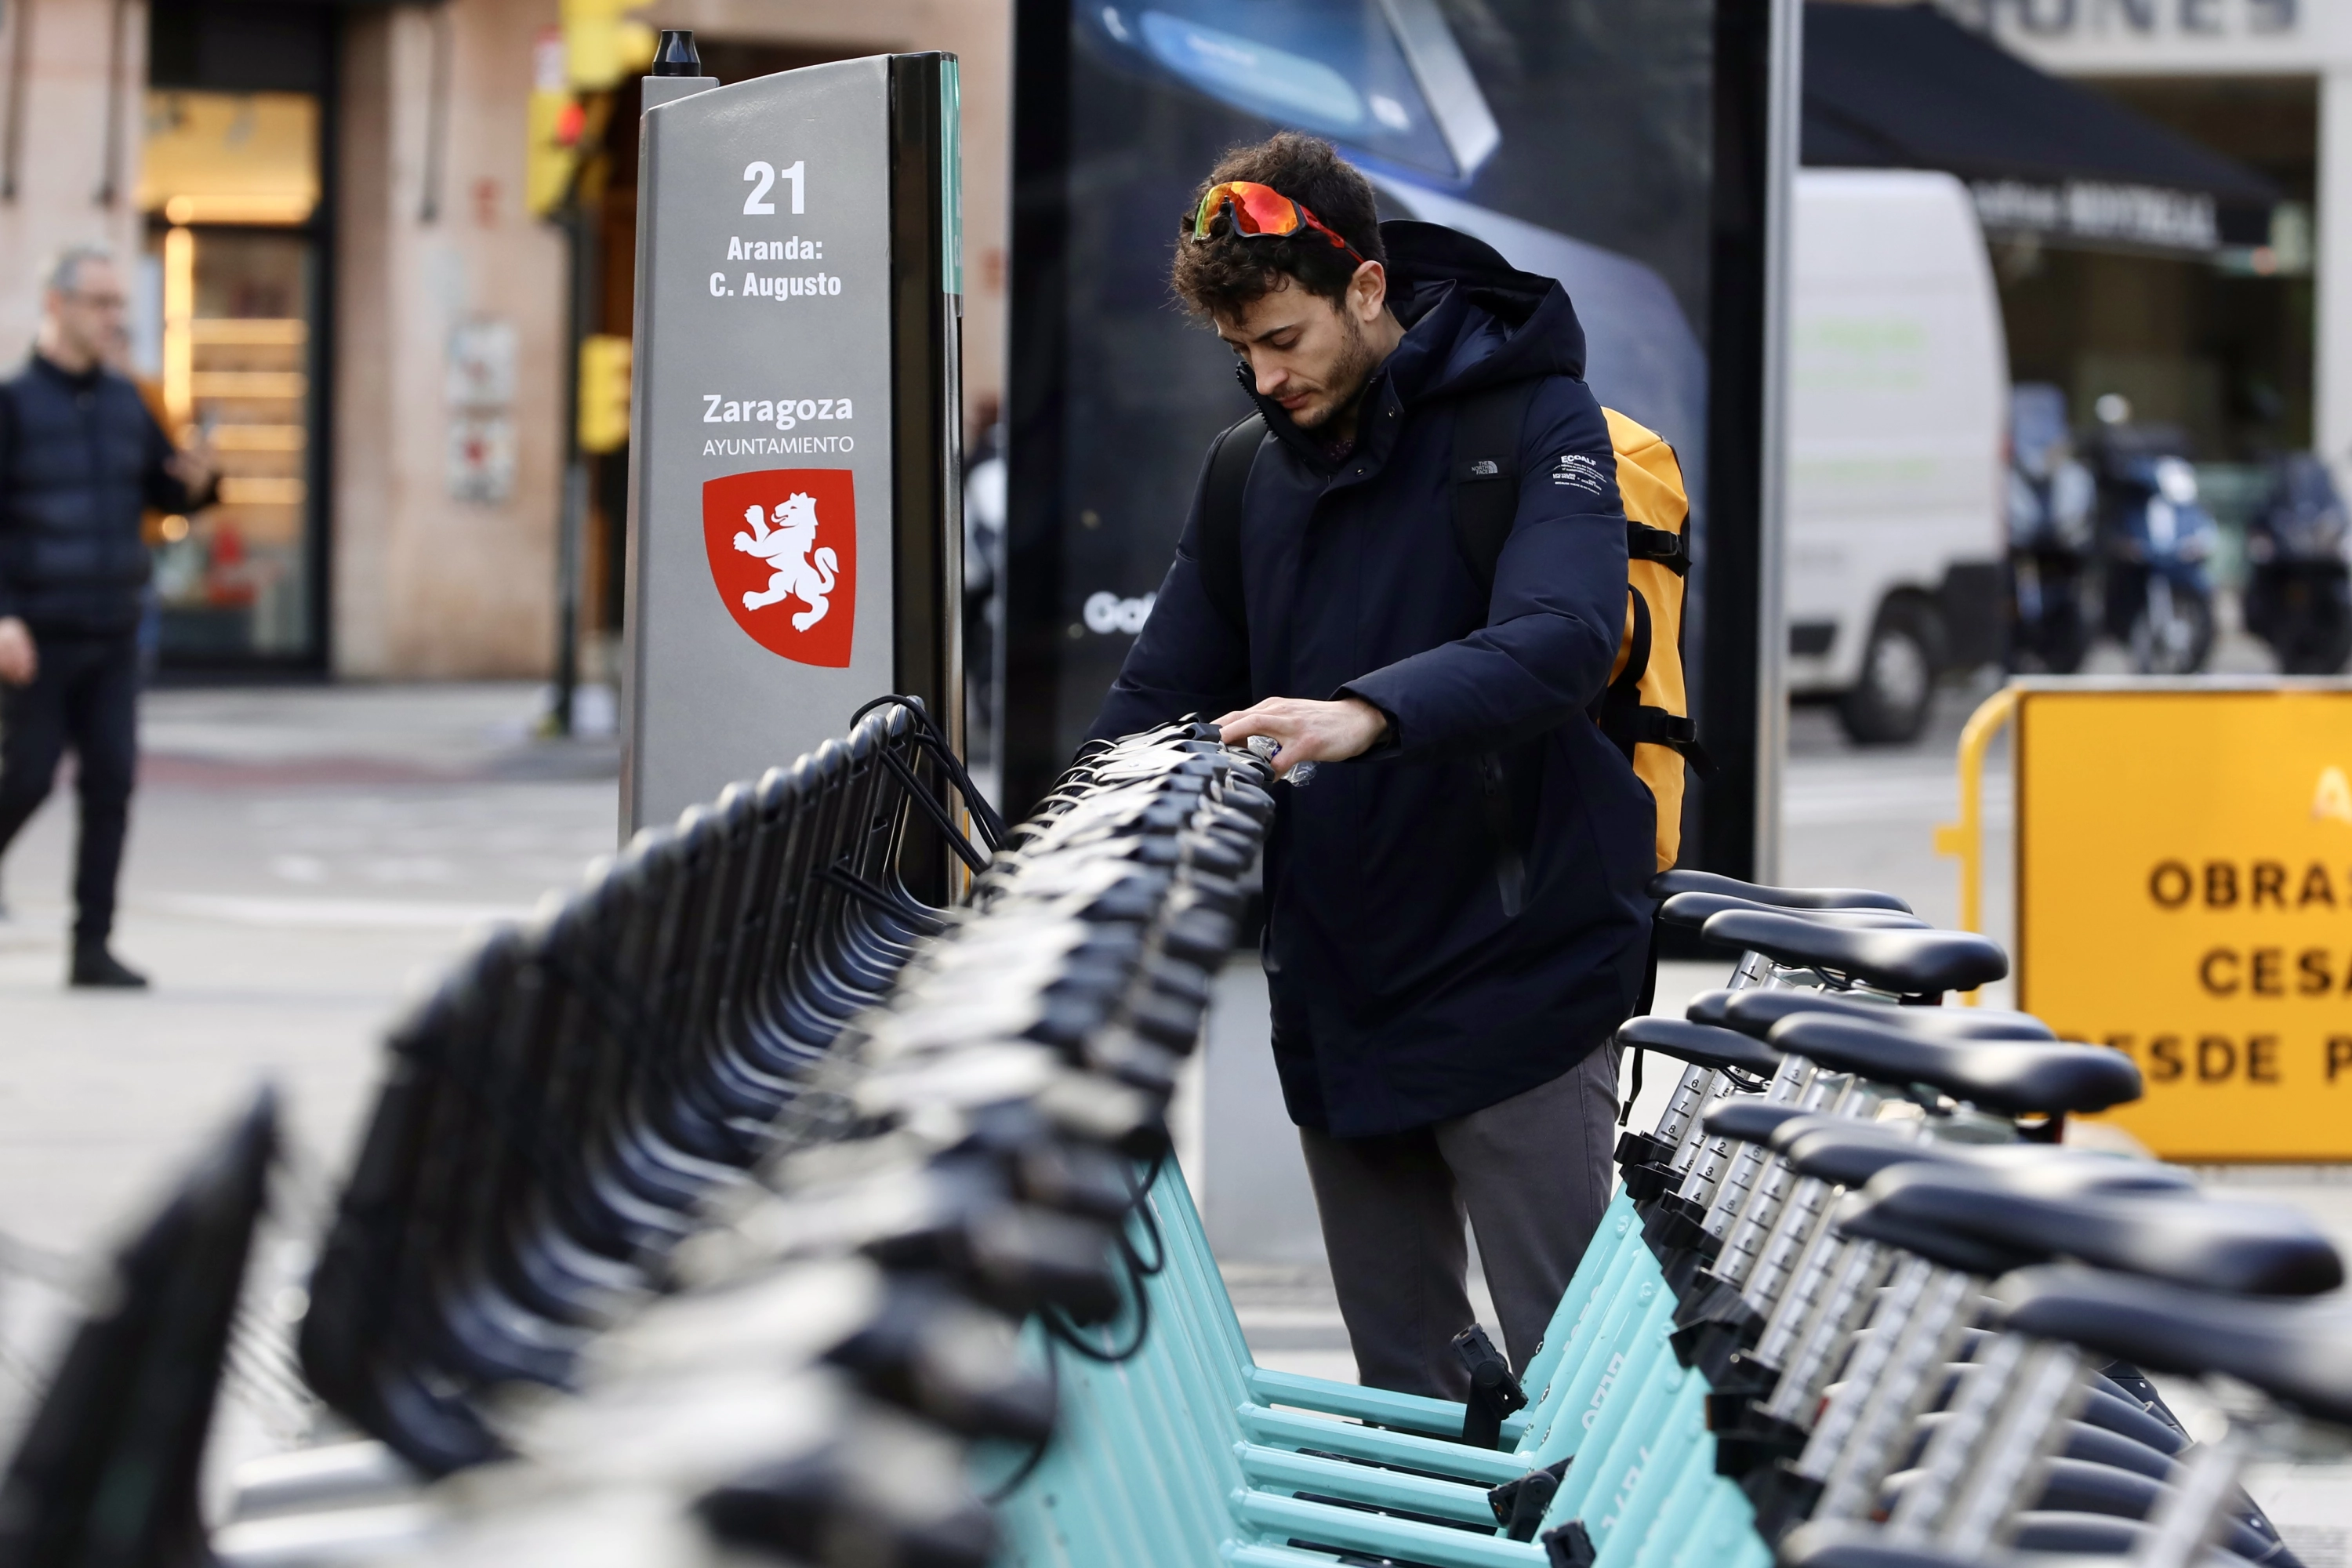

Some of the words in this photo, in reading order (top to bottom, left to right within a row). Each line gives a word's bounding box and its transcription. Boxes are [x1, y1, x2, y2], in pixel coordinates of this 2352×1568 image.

[742, 161, 805, 215] 21
[727, 236, 823, 260] Aranda:
[710, 272, 735, 296] C.
[742, 272, 841, 301] Augusto
[702, 394, 853, 430] Zaragoza
[702, 435, 855, 456] AYUNTAMIENTO
[1561, 455, 1597, 466] ECOALF
[2148, 858, 2352, 912] OBRA
[2056, 1031, 2280, 1087] SDE
[1691, 1079, 1700, 1088] 6
[1680, 1101, 1689, 1111] 7
[1668, 1124, 1676, 1134] 8
[1717, 1142, 1727, 1152] 2
[1705, 1166, 1714, 1177] 3
[1692, 1192, 1702, 1202] 4
